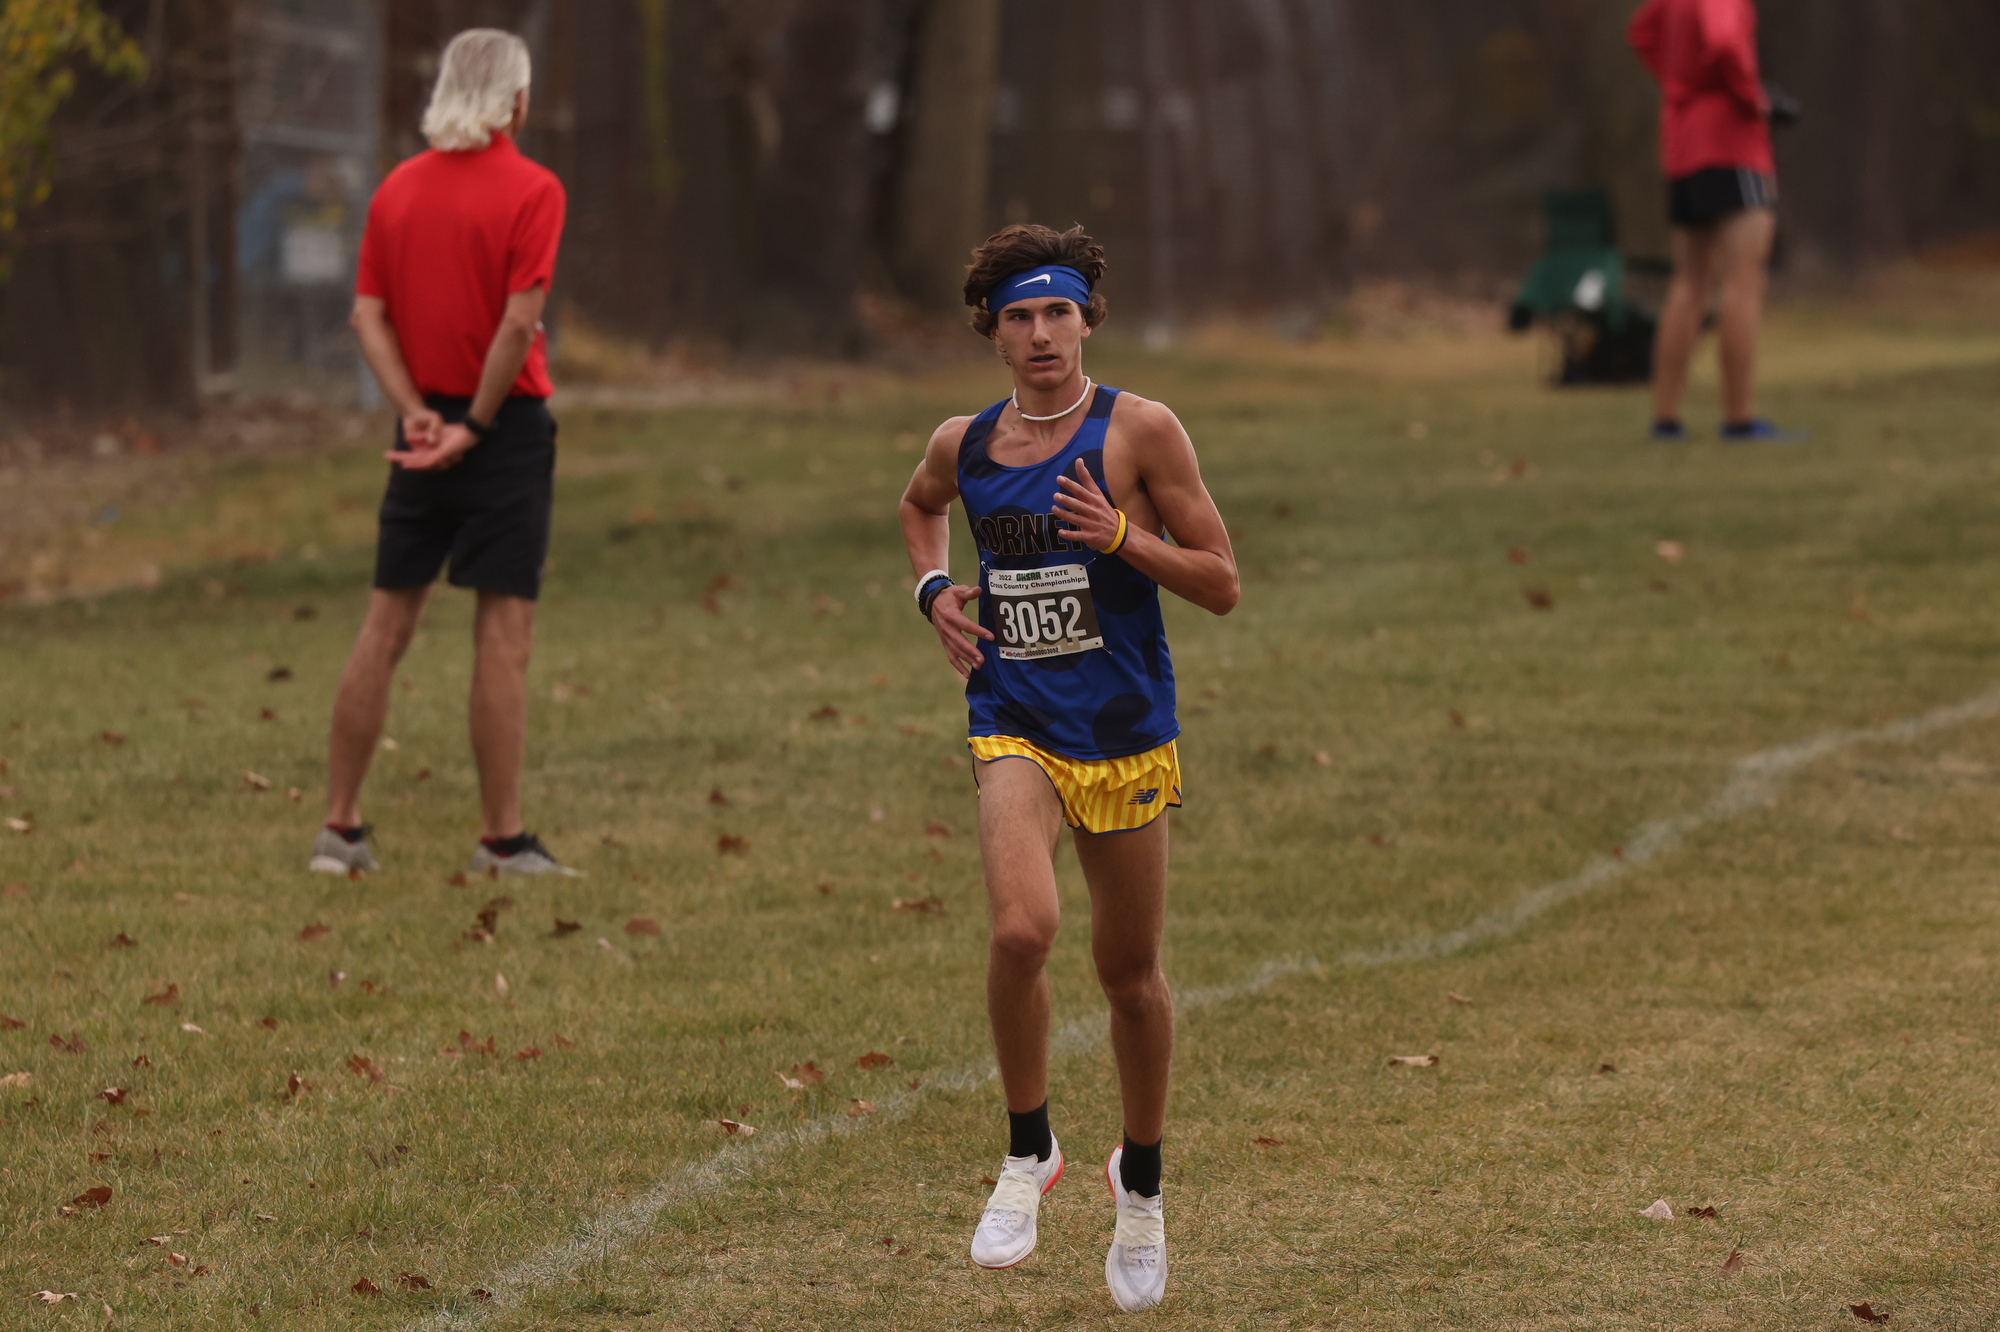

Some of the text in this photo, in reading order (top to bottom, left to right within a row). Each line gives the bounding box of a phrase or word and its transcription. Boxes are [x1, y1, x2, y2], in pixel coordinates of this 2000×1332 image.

[1044, 569, 1069, 578] STATE
[990, 581, 1003, 589] Cross
[1030, 576, 1086, 588] Championships
[999, 596, 1087, 644] 3052
